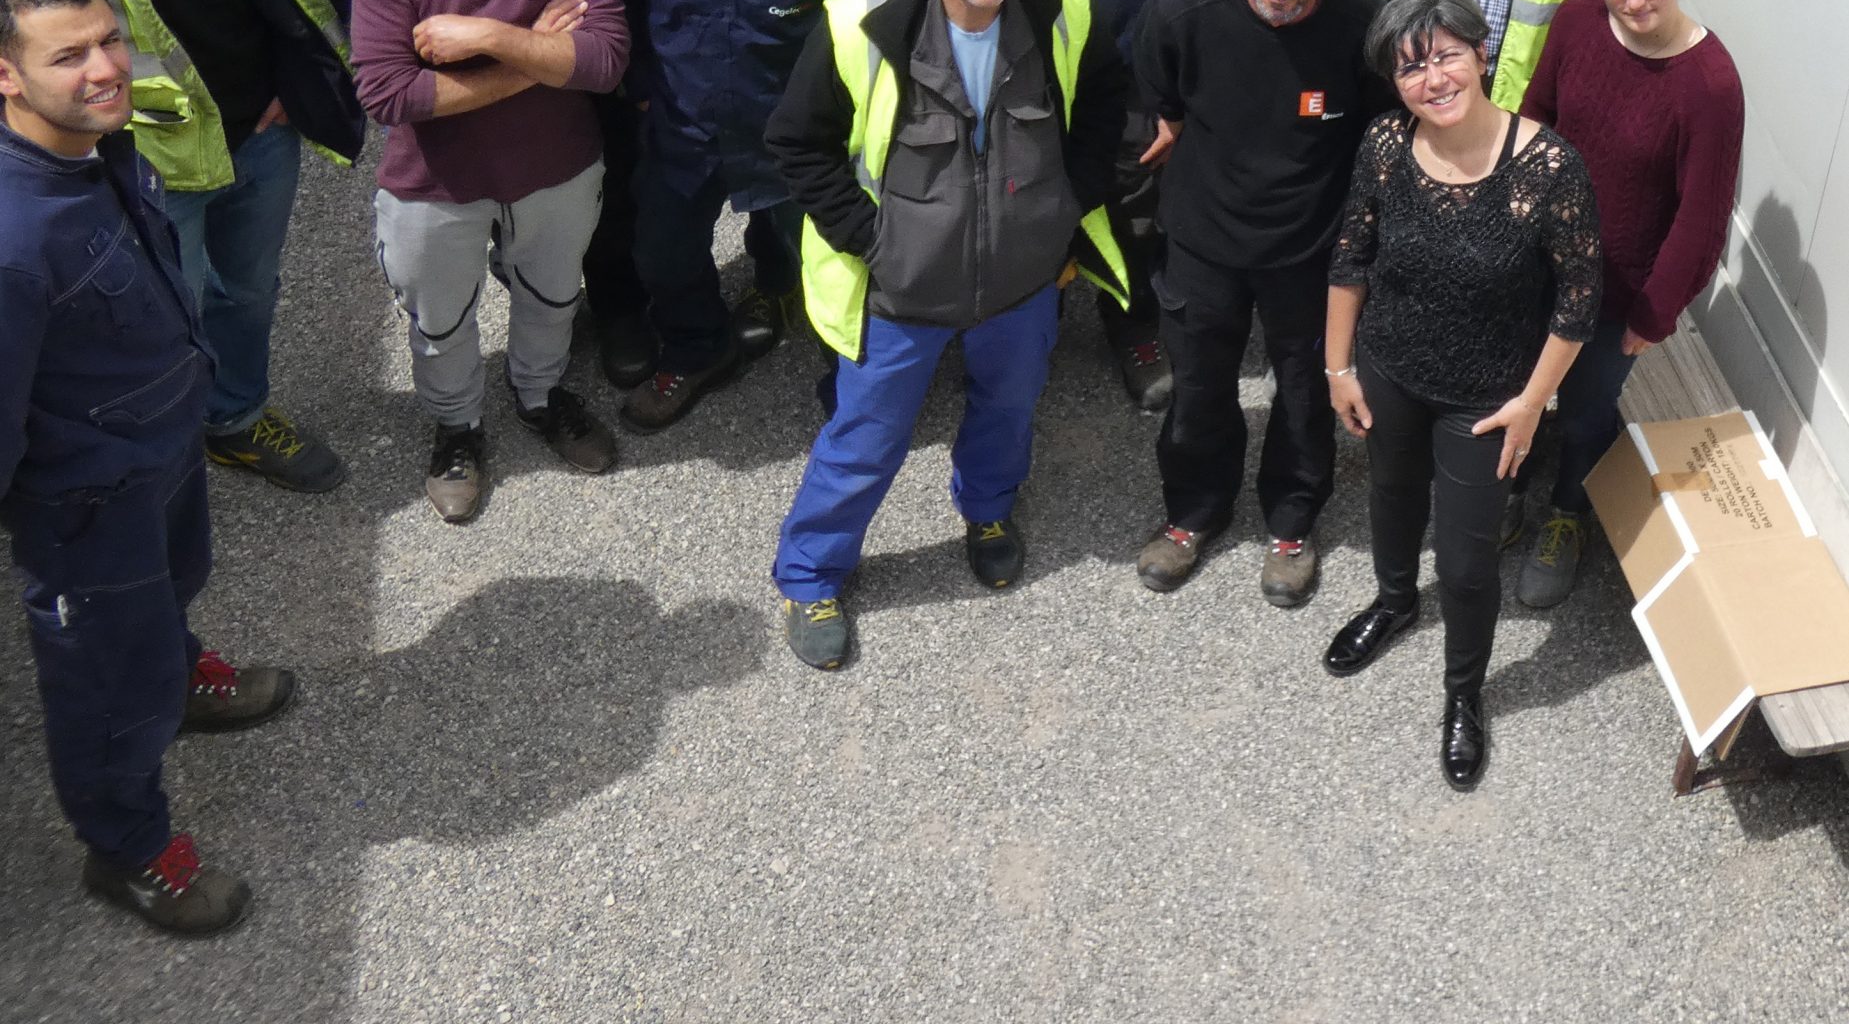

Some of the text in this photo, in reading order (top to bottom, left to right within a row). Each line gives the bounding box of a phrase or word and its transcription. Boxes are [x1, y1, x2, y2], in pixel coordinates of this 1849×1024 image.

[1699, 441, 1721, 474] CARTON
[1739, 494, 1761, 530] CARTON
[1753, 499, 1773, 528] BATCH
